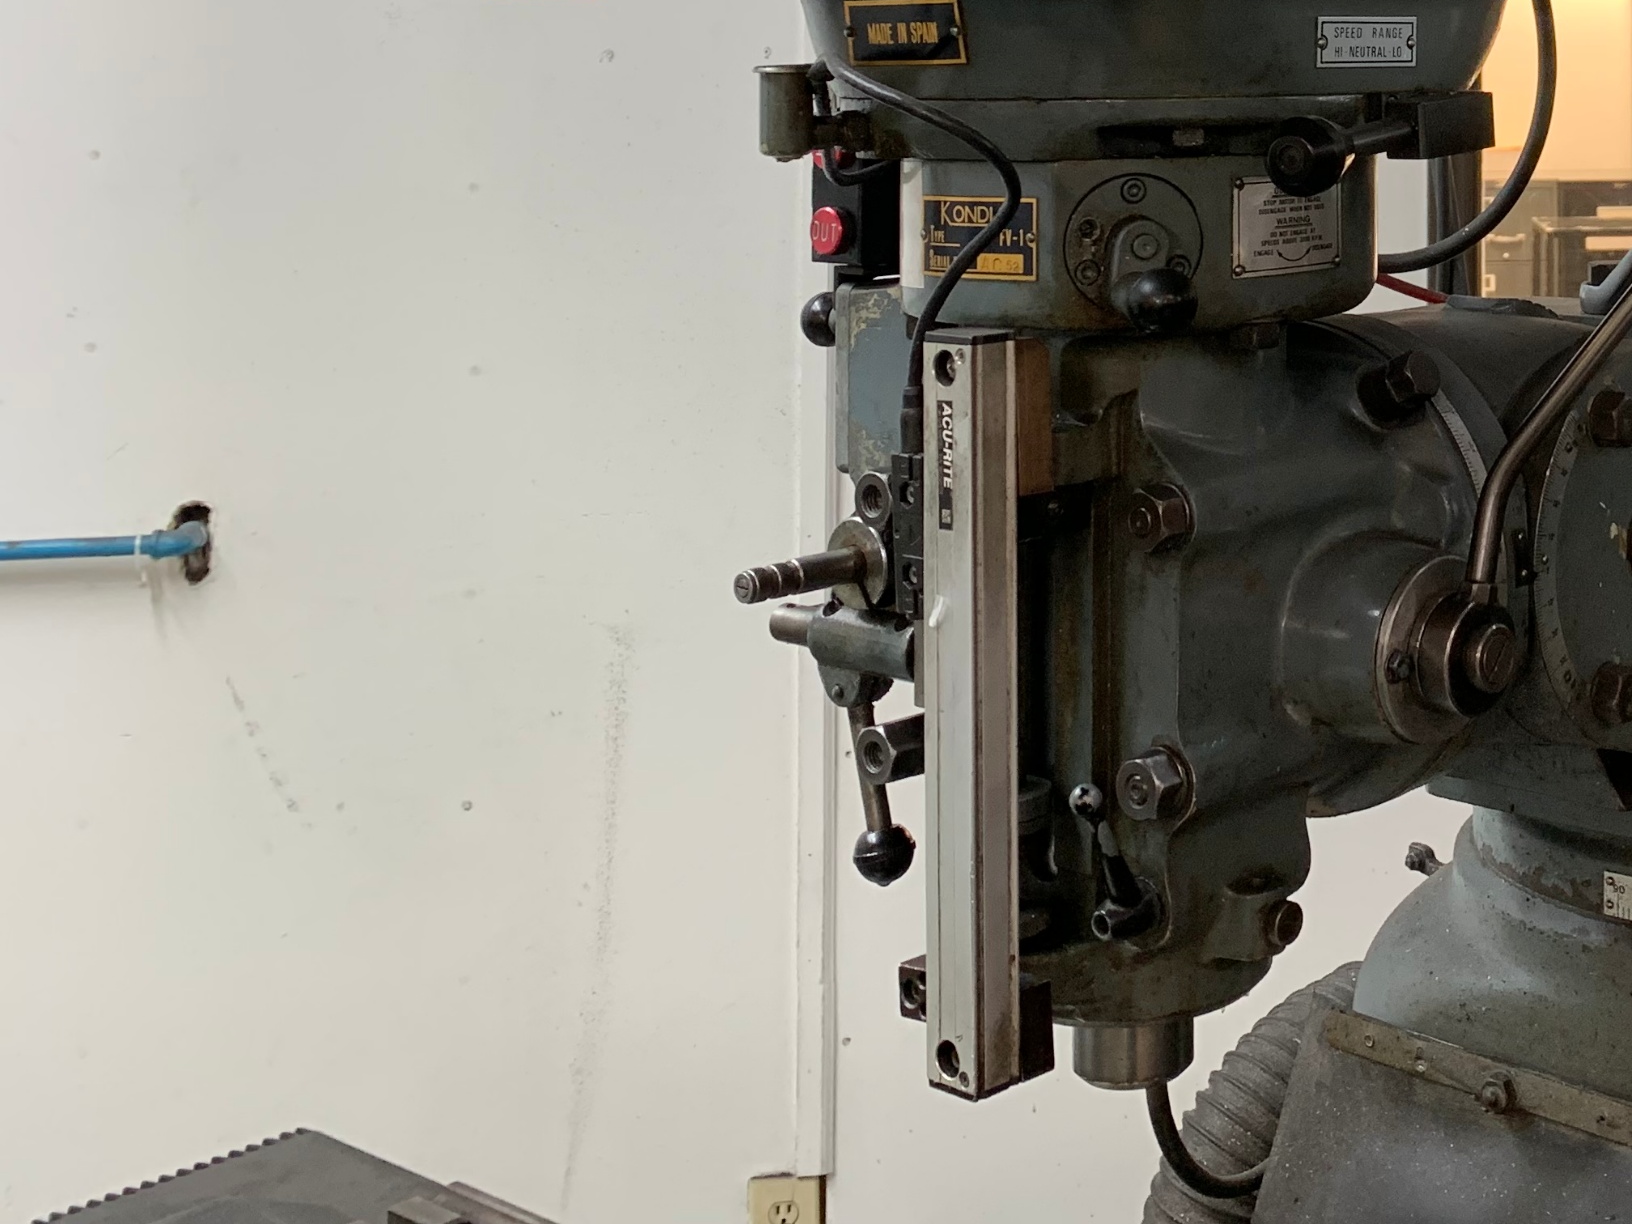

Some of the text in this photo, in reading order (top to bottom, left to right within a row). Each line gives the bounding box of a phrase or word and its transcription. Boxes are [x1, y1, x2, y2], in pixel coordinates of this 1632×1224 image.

[868, 22, 938, 44] MADE IN SPAIN
[1334, 27, 1403, 38] SPEED RANGE
[941, 201, 995, 226] KONDI
[1276, 215, 1310, 224] WARNING
[812, 221, 836, 242] OUT
[941, 402, 953, 490] ACU-RITE
[1613, 884, 1626, 894] 90
